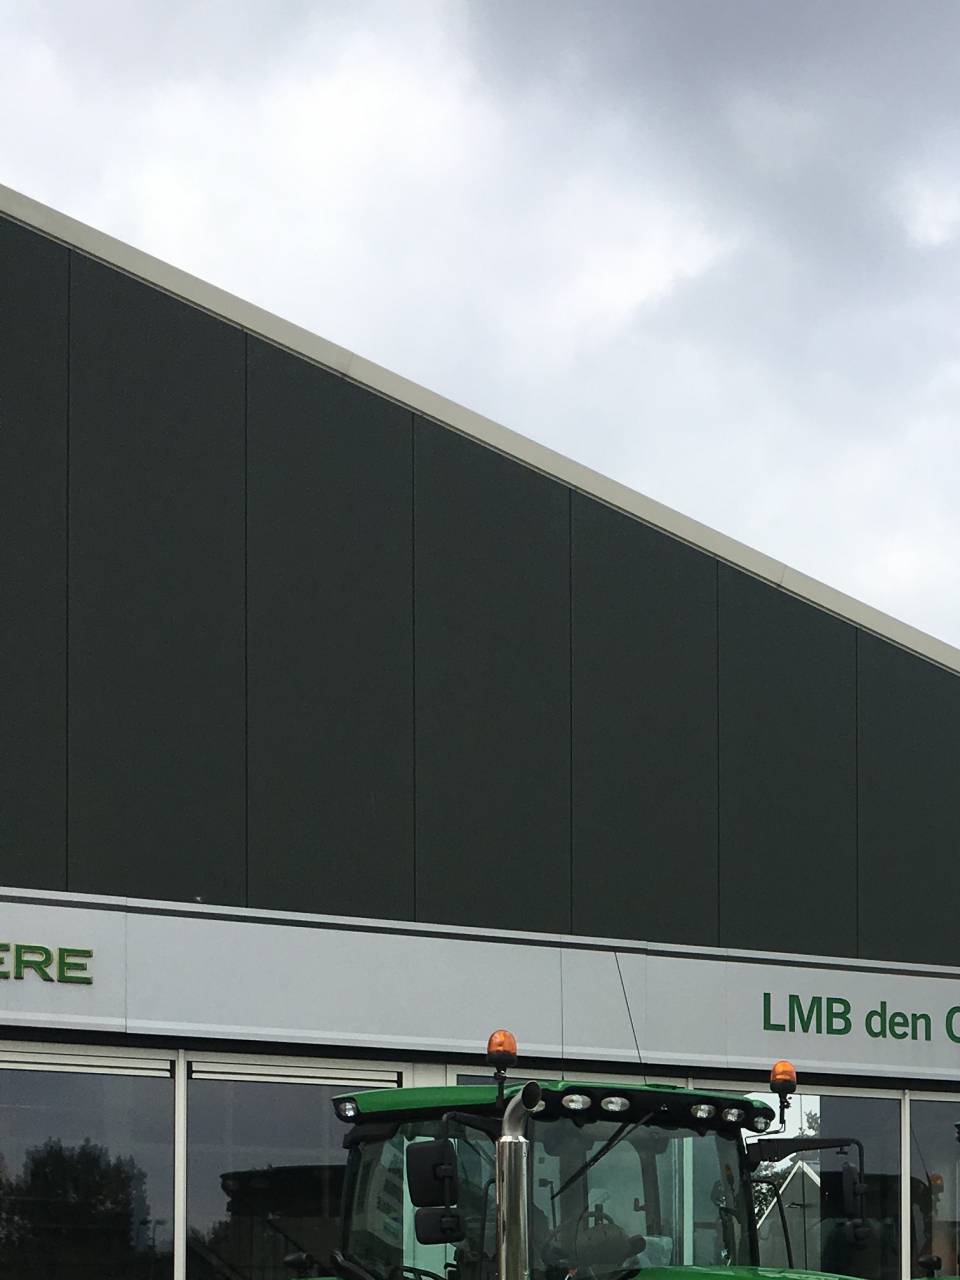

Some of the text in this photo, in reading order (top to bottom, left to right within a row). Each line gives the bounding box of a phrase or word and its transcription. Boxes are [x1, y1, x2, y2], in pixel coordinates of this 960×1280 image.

[0, 943, 94, 985] RE
[763, 992, 851, 1036] LMB
[865, 1001, 931, 1041] den
